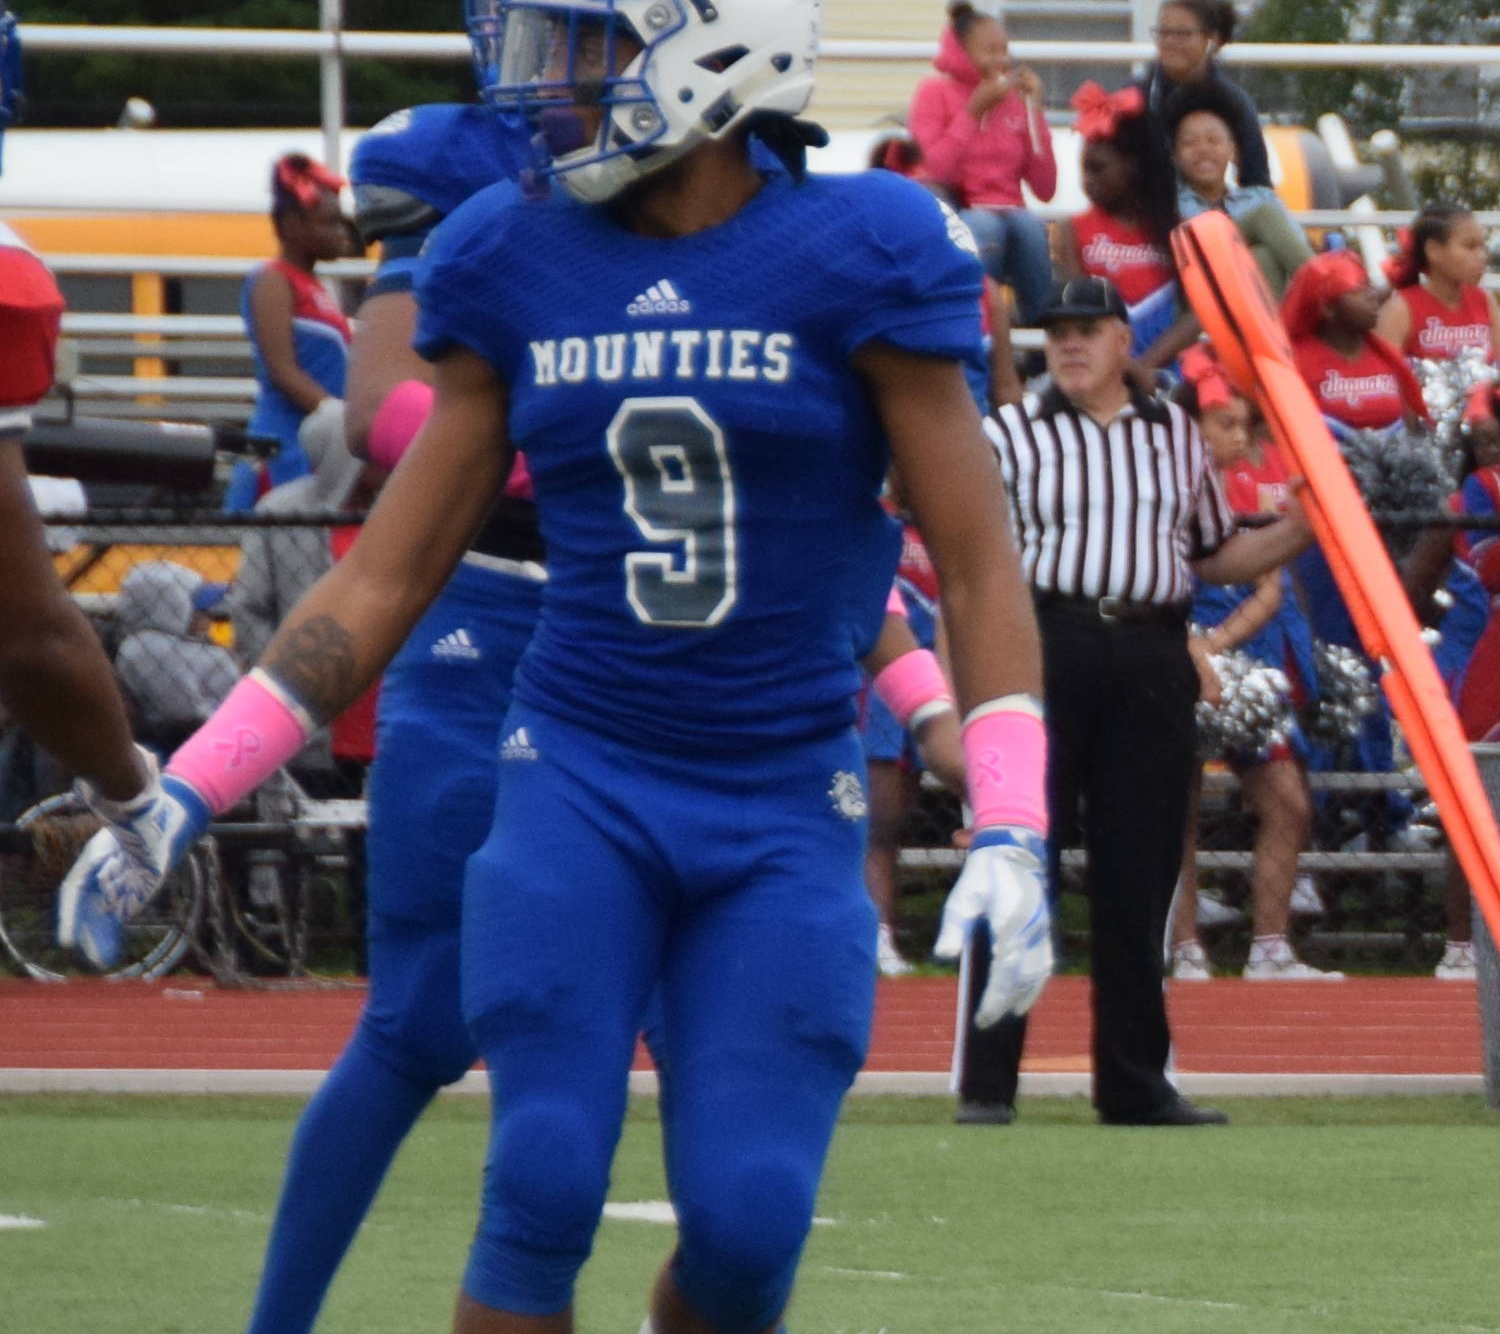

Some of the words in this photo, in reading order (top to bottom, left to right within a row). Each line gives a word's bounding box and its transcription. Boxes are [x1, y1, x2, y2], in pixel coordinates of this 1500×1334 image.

[626, 298, 690, 316] adidas
[530, 329, 794, 385] MOUNTIES
[606, 396, 737, 627] 9
